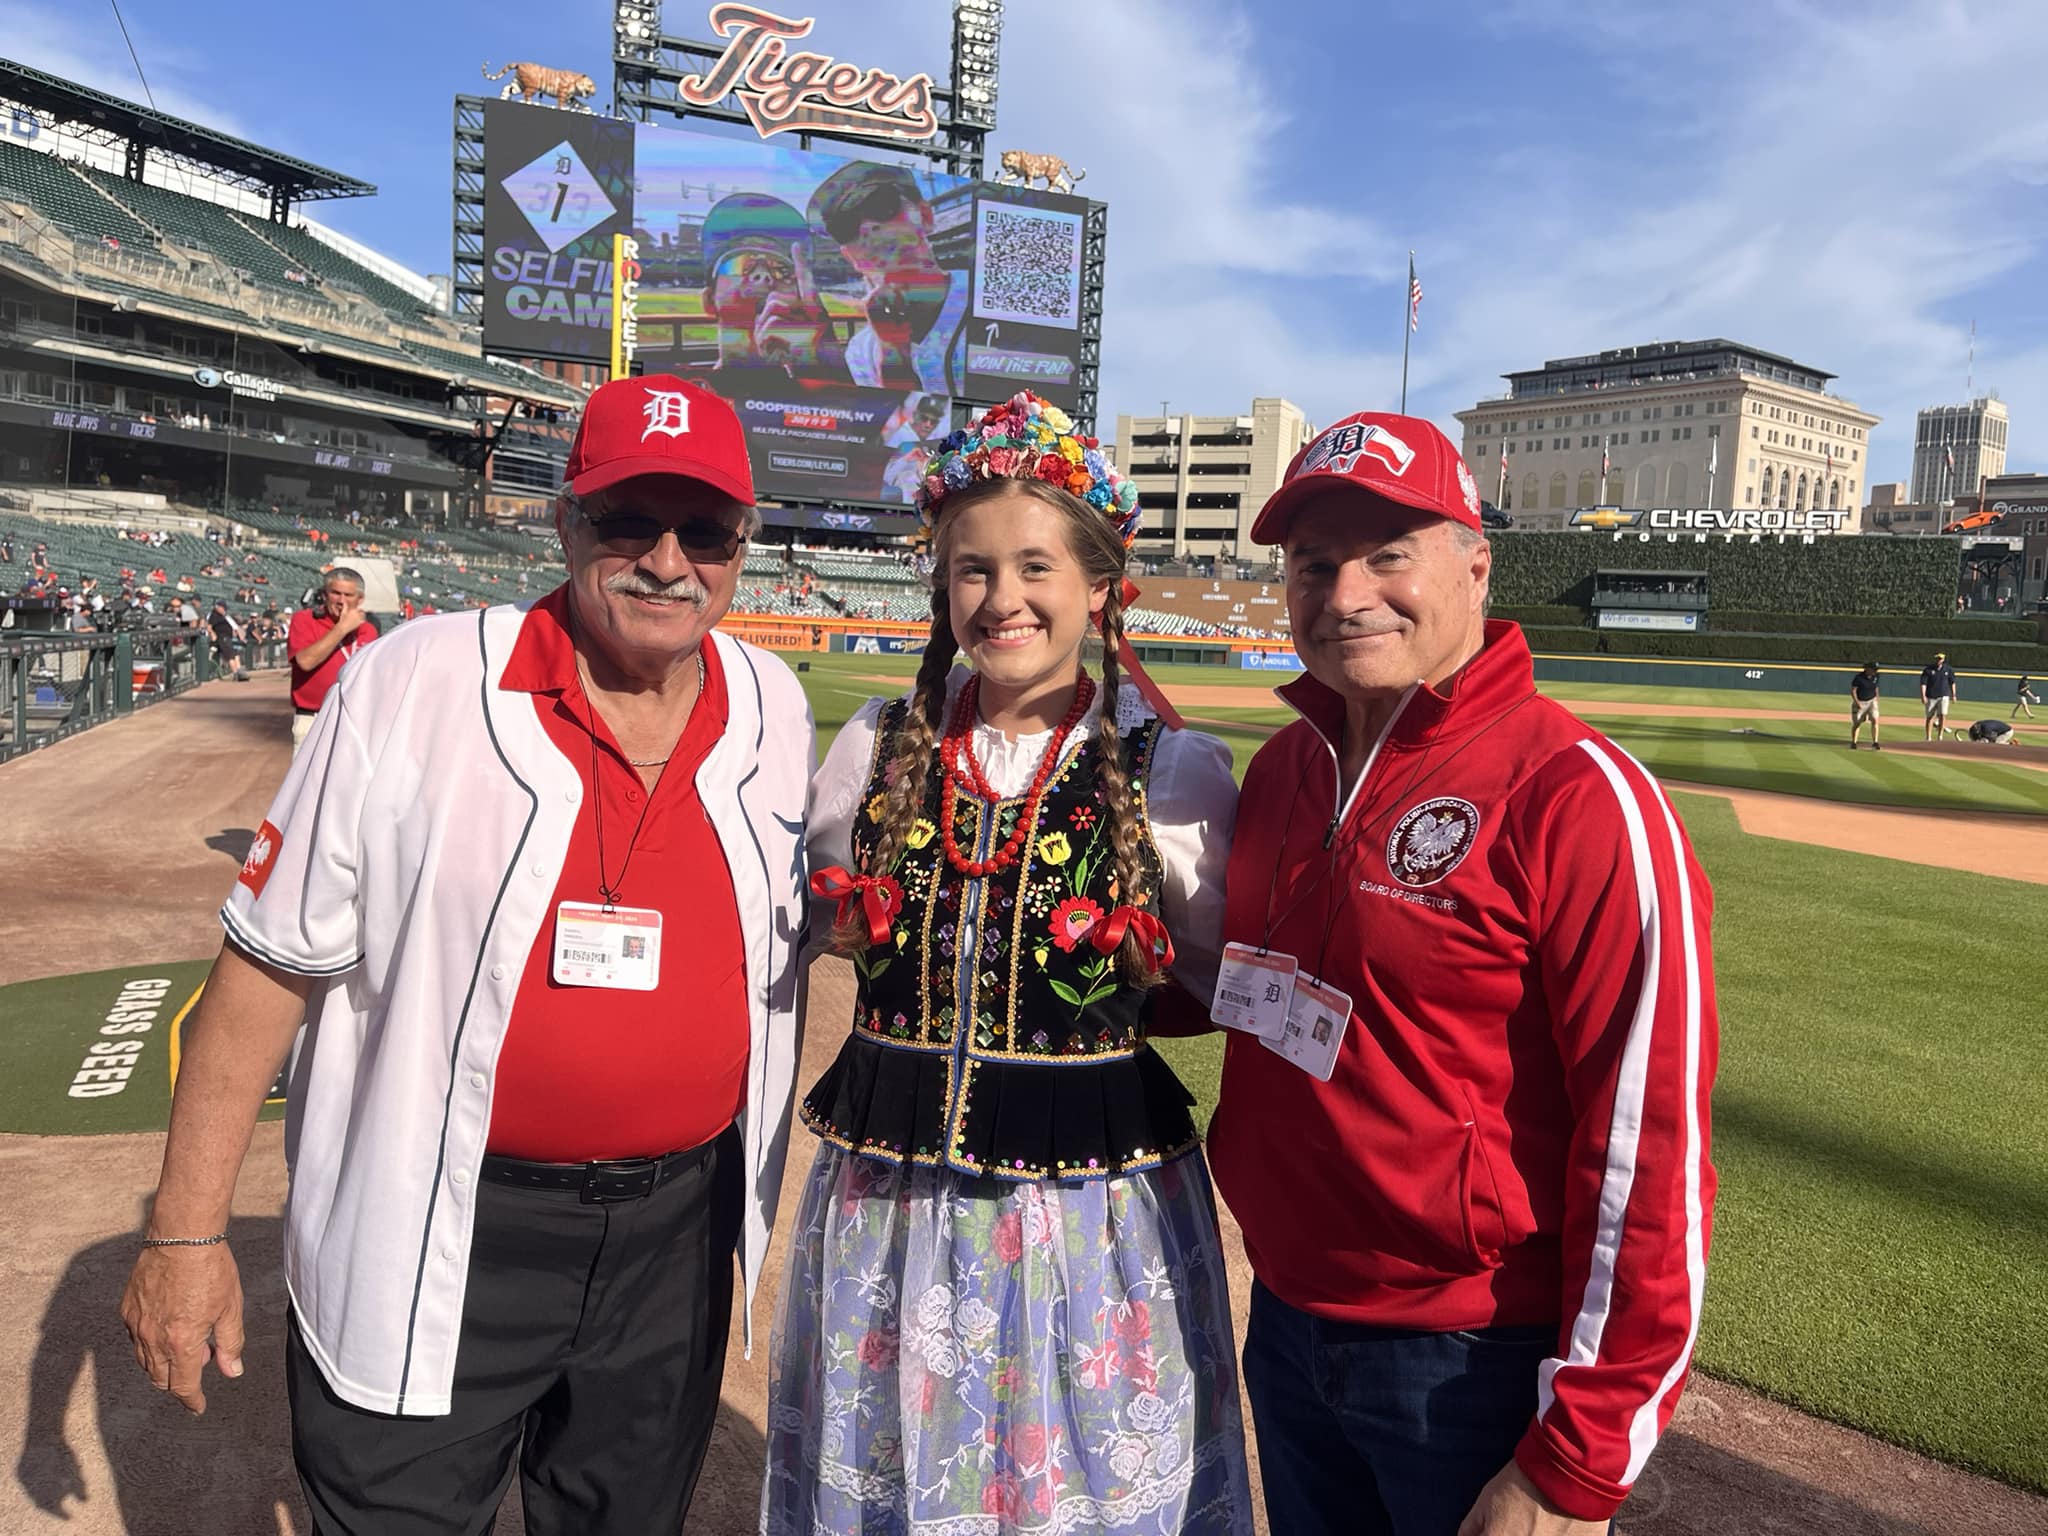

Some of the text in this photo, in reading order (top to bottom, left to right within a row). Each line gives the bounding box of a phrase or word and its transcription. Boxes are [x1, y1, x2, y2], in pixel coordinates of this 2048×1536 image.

[679, 2, 938, 139] Tigers
[491, 246, 614, 293] SELFI
[505, 285, 613, 330] CAM
[621, 239, 642, 361] ROCKET
[223, 370, 286, 394] Gallagher
[53, 412, 77, 427] BLUE
[75, 416, 99, 431] JAYS
[129, 422, 157, 438] TIGERS
[640, 387, 691, 444] D
[855, 411, 874, 422] NY
[1650, 508, 1848, 530] CHEVROLET
[1613, 532, 1815, 545] FOUNTAIN
[1213, 581, 1220, 593] 5
[1261, 585, 1269, 597] 2
[1360, 880, 1458, 911] BOARD OF DIRECTORS
[99, 978, 172, 1035] GRASS
[68, 1040, 144, 1098] SEED
